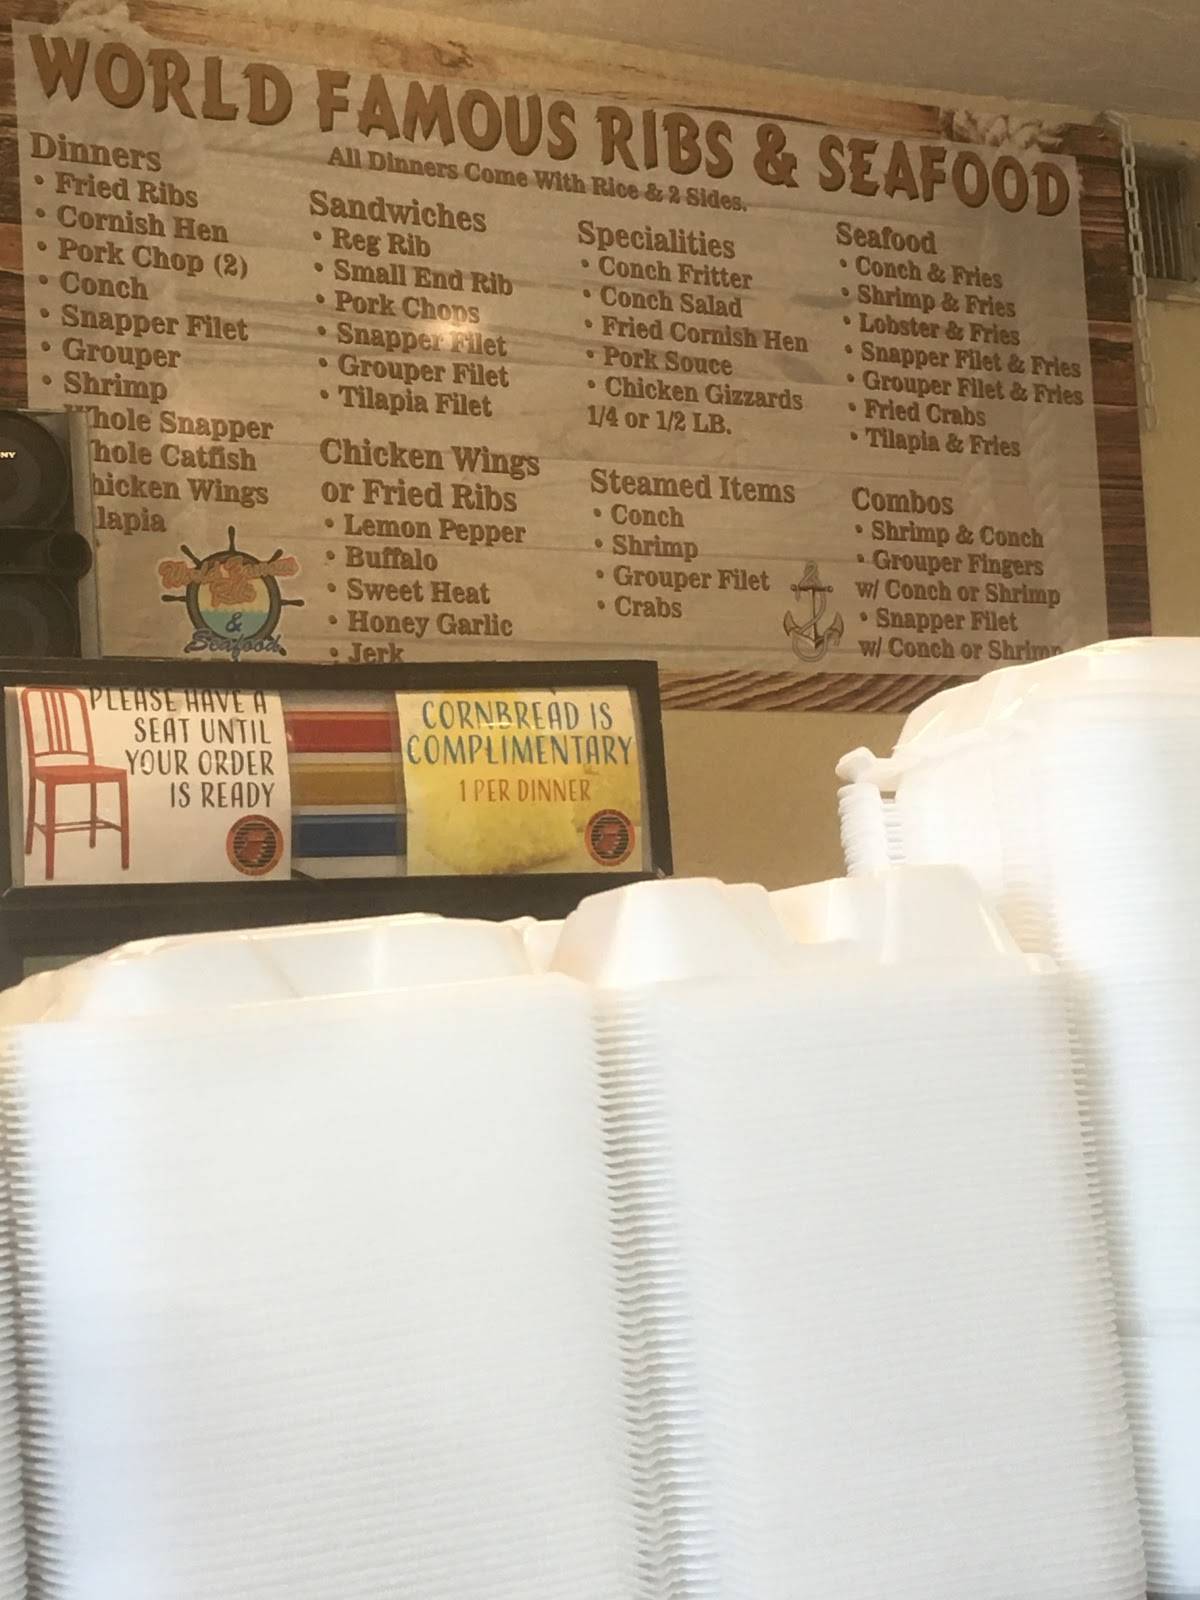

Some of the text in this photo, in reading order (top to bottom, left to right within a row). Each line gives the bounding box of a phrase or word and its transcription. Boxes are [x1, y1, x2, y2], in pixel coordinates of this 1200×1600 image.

[29, 34, 1070, 216] WORLD FAMOUS RIBS & SEAFOOD
[30, 131, 162, 172] Dinners
[55, 172, 198, 208] Fried Ribs
[327, 147, 747, 212] All Dinners Come With Rice & 2 Sides.
[57, 205, 228, 243] Cornish Hen
[309, 190, 487, 233] Sandwiches
[331, 226, 431, 258] Reg Rib
[578, 220, 736, 259] Specialities
[835, 221, 937, 254] Seafood
[58, 237, 248, 280] Pork Chop (2)
[599, 255, 752, 290] Conch Fritter
[855, 255, 1003, 289] Conch & Fries
[59, 270, 148, 300] Conch
[334, 259, 513, 296] Small End Rib
[335, 289, 480, 323] Pork Chops
[600, 285, 743, 319] Conch Salad
[857, 284, 1016, 318] Shrimp & Fries
[61, 304, 248, 341] Snapper Filet
[602, 315, 809, 353] Fried Cornish Hen
[859, 312, 1020, 346] Lobster & Fries
[62, 337, 181, 370] Grouper
[337, 322, 507, 357] Snapper Filet
[338, 353, 509, 388] Grouper Filet
[603, 346, 733, 376] Pork Souce
[861, 341, 1081, 378] Snapper Filet & Fries
[64, 370, 168, 404] Shrimp
[338, 385, 492, 417] Tilapia Filet
[605, 375, 804, 411] Chicken Gizzards
[862, 370, 1084, 406] Grouper Filet & Fries
[160, 411, 274, 442] Snapper
[587, 404, 732, 435] 1/4 or 1/2 LB.
[864, 398, 986, 427] Fried Crabs
[90, 439, 257, 471] hole Catfish
[865, 427, 1021, 457] Tilapia & Fries
[319, 438, 540, 480] Chicken Wings
[92, 472, 269, 508] hicken Wings
[321, 478, 517, 512] or Fried Ribs
[591, 468, 796, 504] Steamed Items
[852, 486, 954, 515] Combos
[96, 506, 167, 535] lapia
[344, 513, 526, 546] Lemon Pepper
[610, 504, 685, 528] Conch
[612, 534, 699, 563] Shrimp
[871, 520, 1044, 548] Shrimp & Conch
[345, 546, 438, 571] Buffalo
[872, 550, 1044, 578] Grouper Fingers
[347, 578, 490, 604] Sweet Heat
[613, 565, 770, 592] Grouper Filet
[855, 579, 1061, 608] w/ Conch or Shrimp
[614, 595, 682, 618] Crabs
[876, 607, 1018, 632] Snapper Filet
[347, 610, 513, 638] Honey Garlic
[184, 628, 281, 661] Seafood
[348, 643, 404, 663] Jerk
[858, 637, 882, 658] w/
[888, 637, 957, 660] Conch
[962, 643, 983, 659] or
[89, 687, 267, 714] PLEASE HAVE A
[422, 700, 613, 730] CORNBREAD IS
[134, 717, 272, 745] SEAT UNTIL
[125, 750, 275, 776] YOUR ORDER
[407, 734, 632, 765] COMPLIMENTARY
[170, 782, 275, 808] IS READY
[460, 779, 591, 801] 1 PER DINNER
